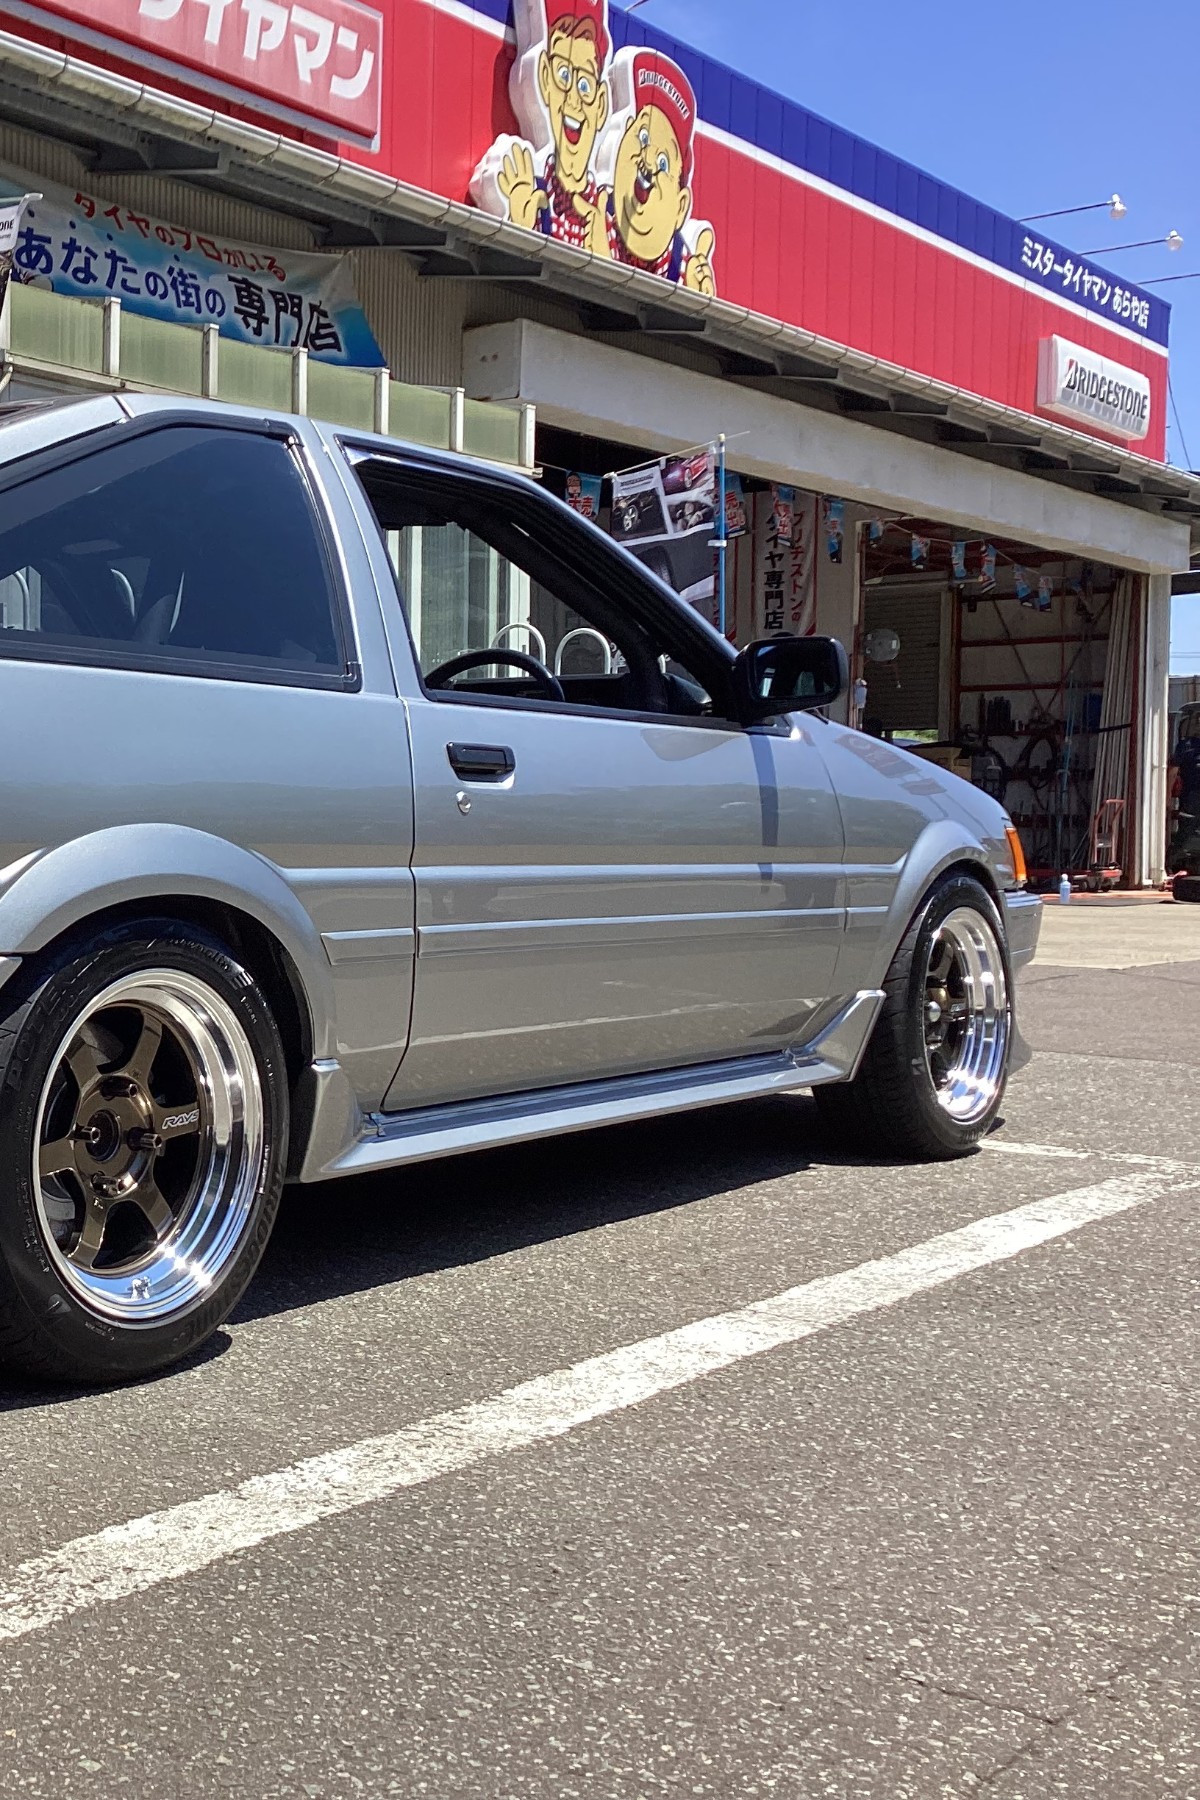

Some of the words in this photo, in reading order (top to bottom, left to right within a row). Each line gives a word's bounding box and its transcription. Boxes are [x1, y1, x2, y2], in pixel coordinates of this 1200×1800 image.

[138, 0, 374, 99] イヤマン
[639, 69, 690, 119] BRIDGESTONE
[1021, 236, 1112, 306] ミスタータイヤマン
[1112, 285, 1150, 330] あらや店
[1065, 358, 1148, 420] BRIDGESTONE
[161, 1108, 200, 1130] RAYS
